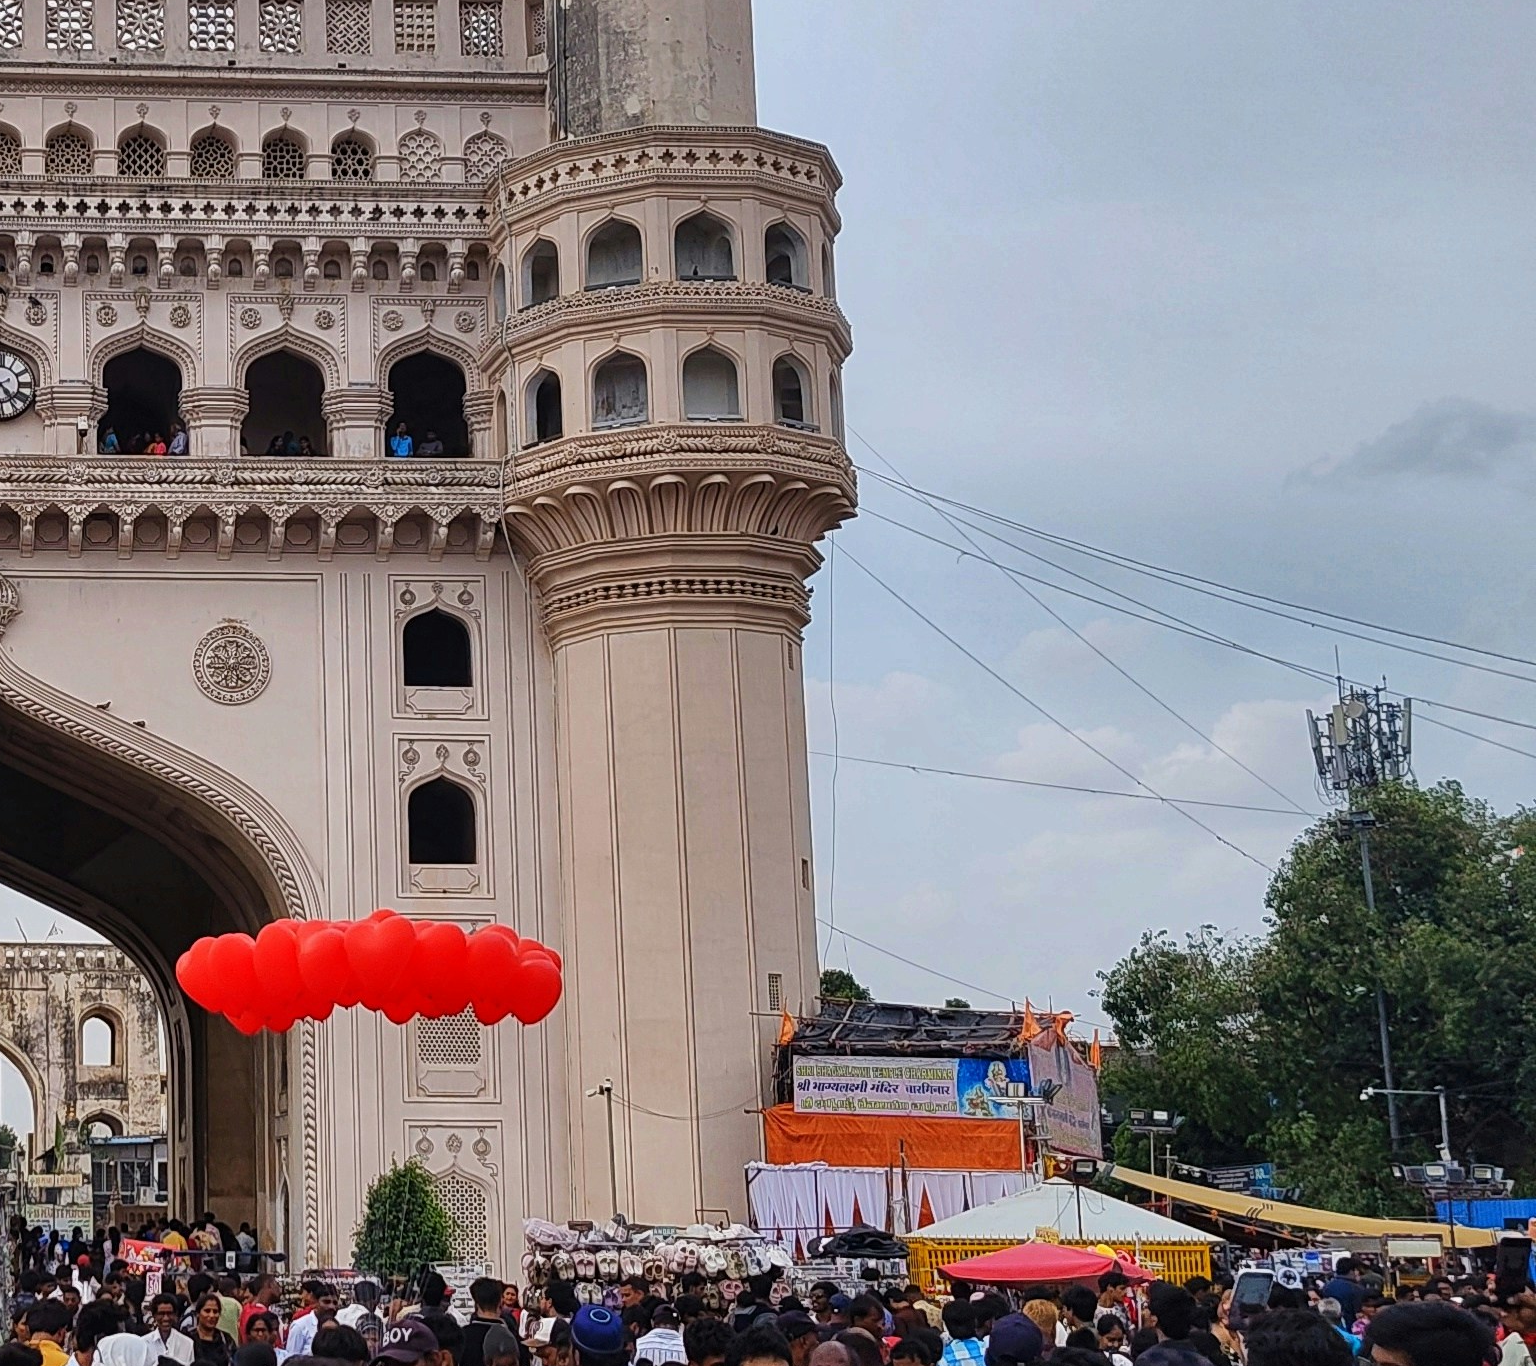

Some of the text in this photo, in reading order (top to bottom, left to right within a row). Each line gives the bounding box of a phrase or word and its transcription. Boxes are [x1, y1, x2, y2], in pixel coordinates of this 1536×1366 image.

[796, 1065, 814, 1076] SHRI
[872, 1066, 904, 1079] TEMPLE
[904, 1067, 954, 1080] CHARMINAR
[797, 1078, 811, 1092] श्री
[382, 1327, 413, 1348] BOY
